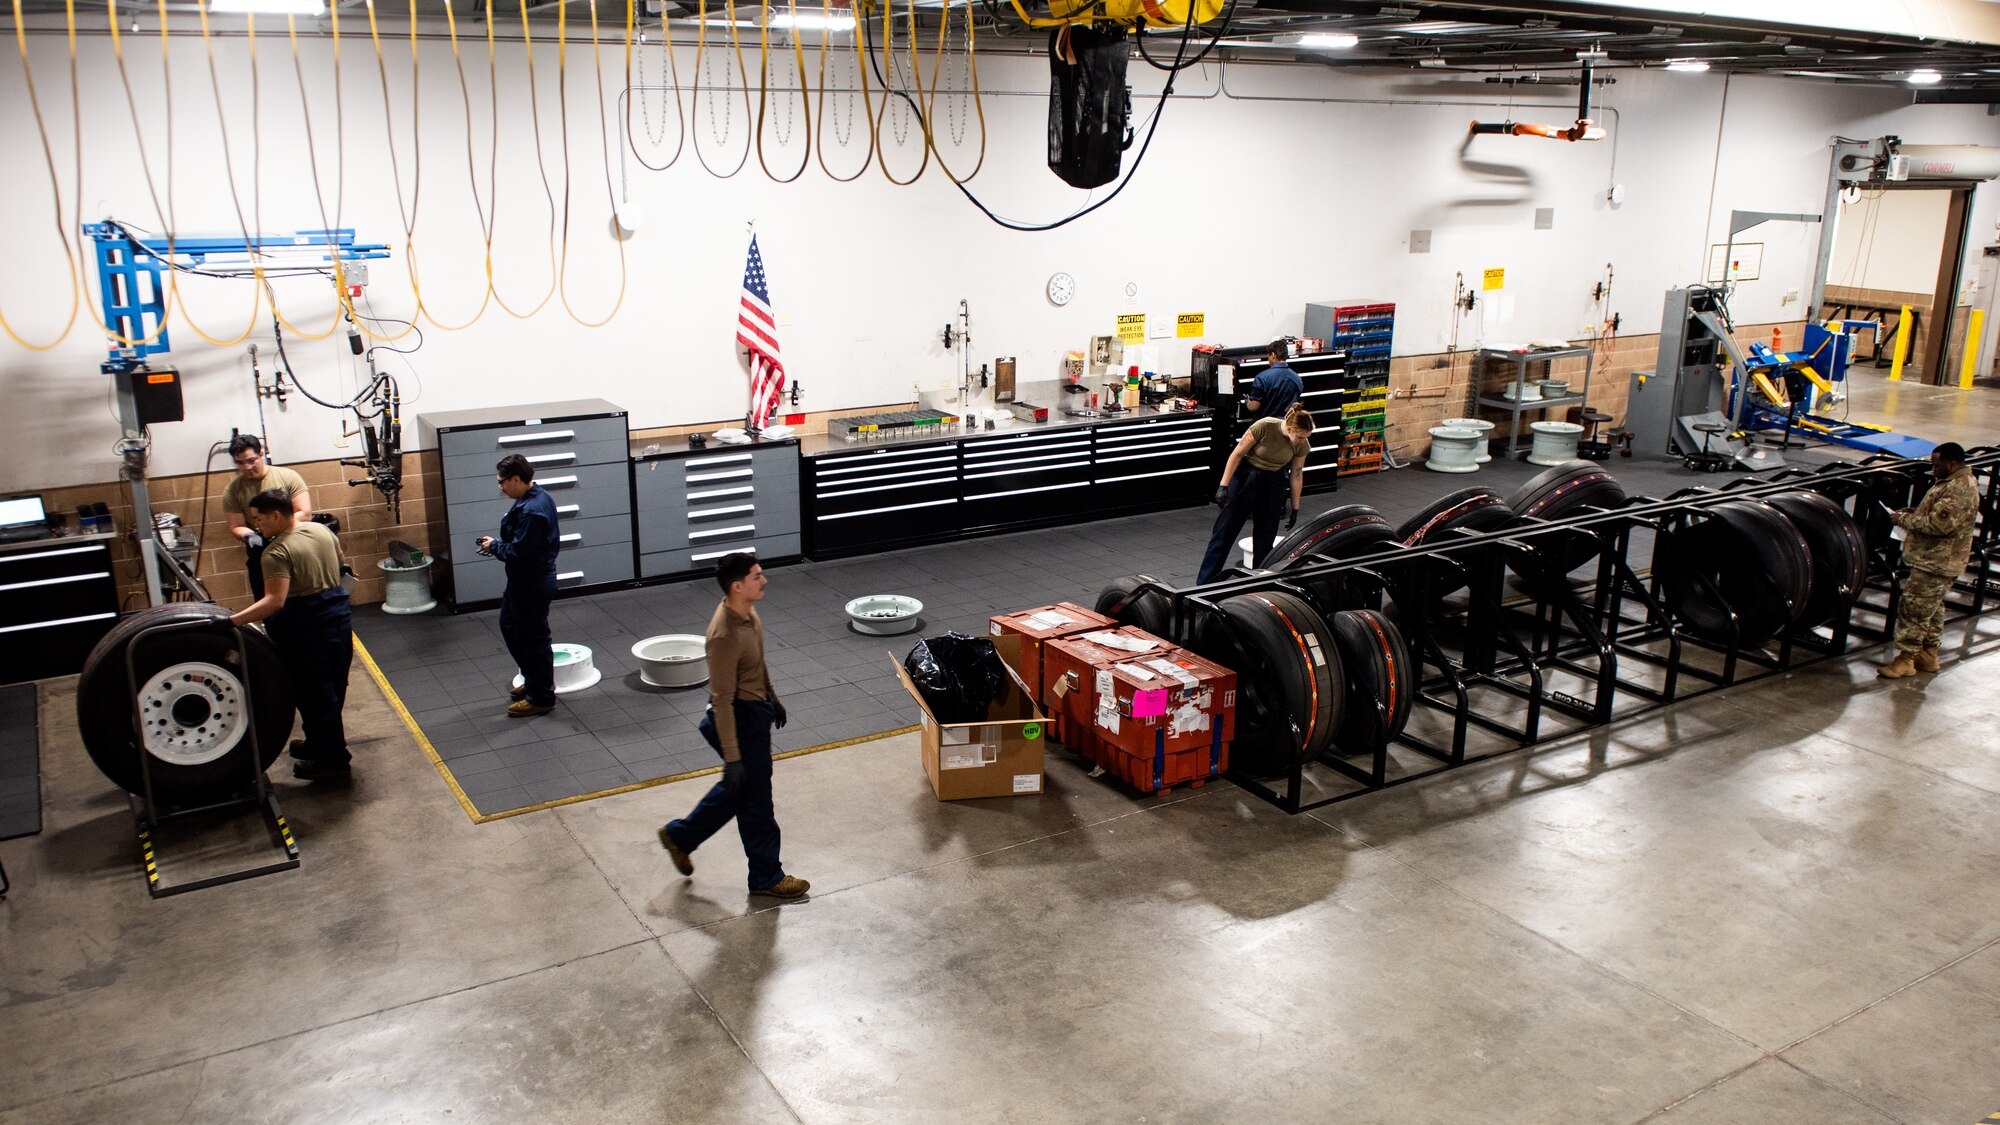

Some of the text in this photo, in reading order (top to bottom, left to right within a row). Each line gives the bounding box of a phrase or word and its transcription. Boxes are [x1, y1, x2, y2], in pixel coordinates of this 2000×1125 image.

[1922, 161, 1955, 174] CORNELL
[1118, 315, 1145, 323] CAUTION
[1179, 315, 1203, 323] CAUTION
[1024, 727, 1039, 735] HDV
